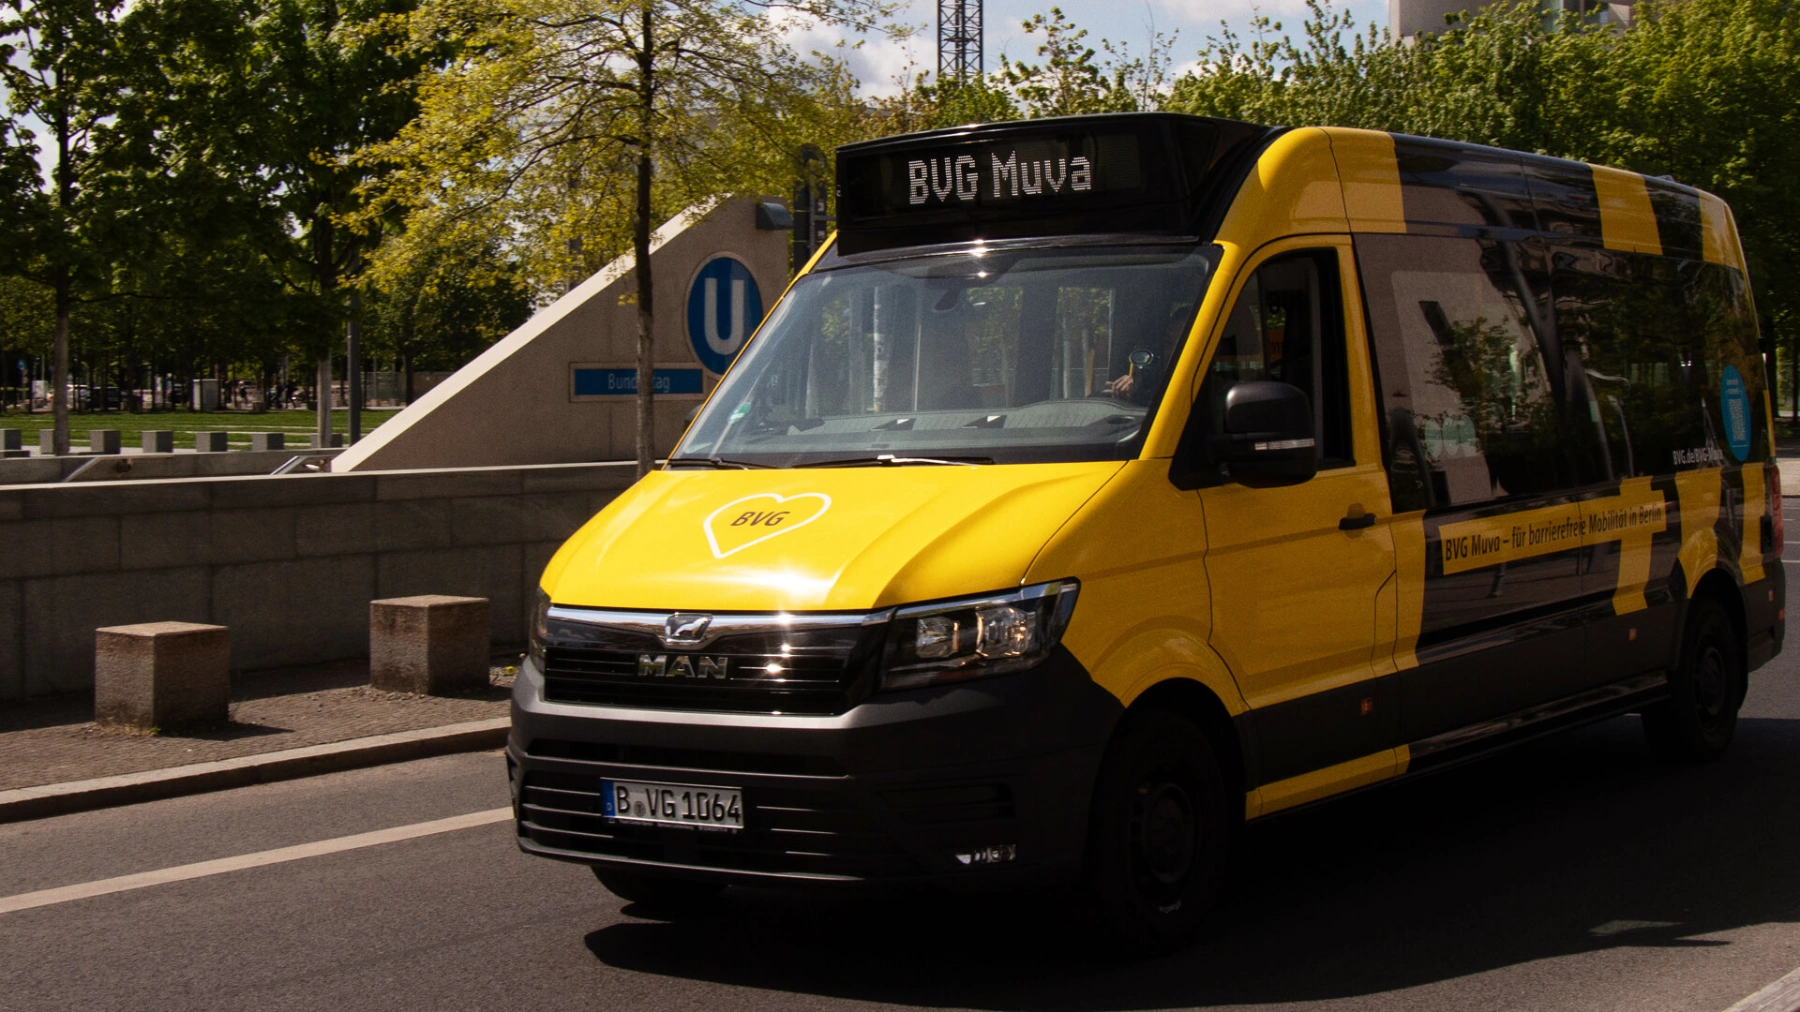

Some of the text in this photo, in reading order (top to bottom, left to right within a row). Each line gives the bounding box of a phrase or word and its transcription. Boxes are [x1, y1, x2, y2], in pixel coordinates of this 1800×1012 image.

[908, 150, 1092, 205] BVG Muva
[704, 277, 745, 355] U
[607, 373, 670, 393] Bundtag
[730, 511, 792, 527] BVG
[1445, 536, 1469, 561] BVG
[1471, 534, 1501, 556] Muva
[1512, 525, 1527, 548] für
[1528, 516, 1587, 546] barrierefreie
[1588, 508, 1628, 535] Mobilität
[1629, 506, 1637, 526] in
[1639, 502, 1662, 525] Berlin
[637, 654, 729, 679] MAN
